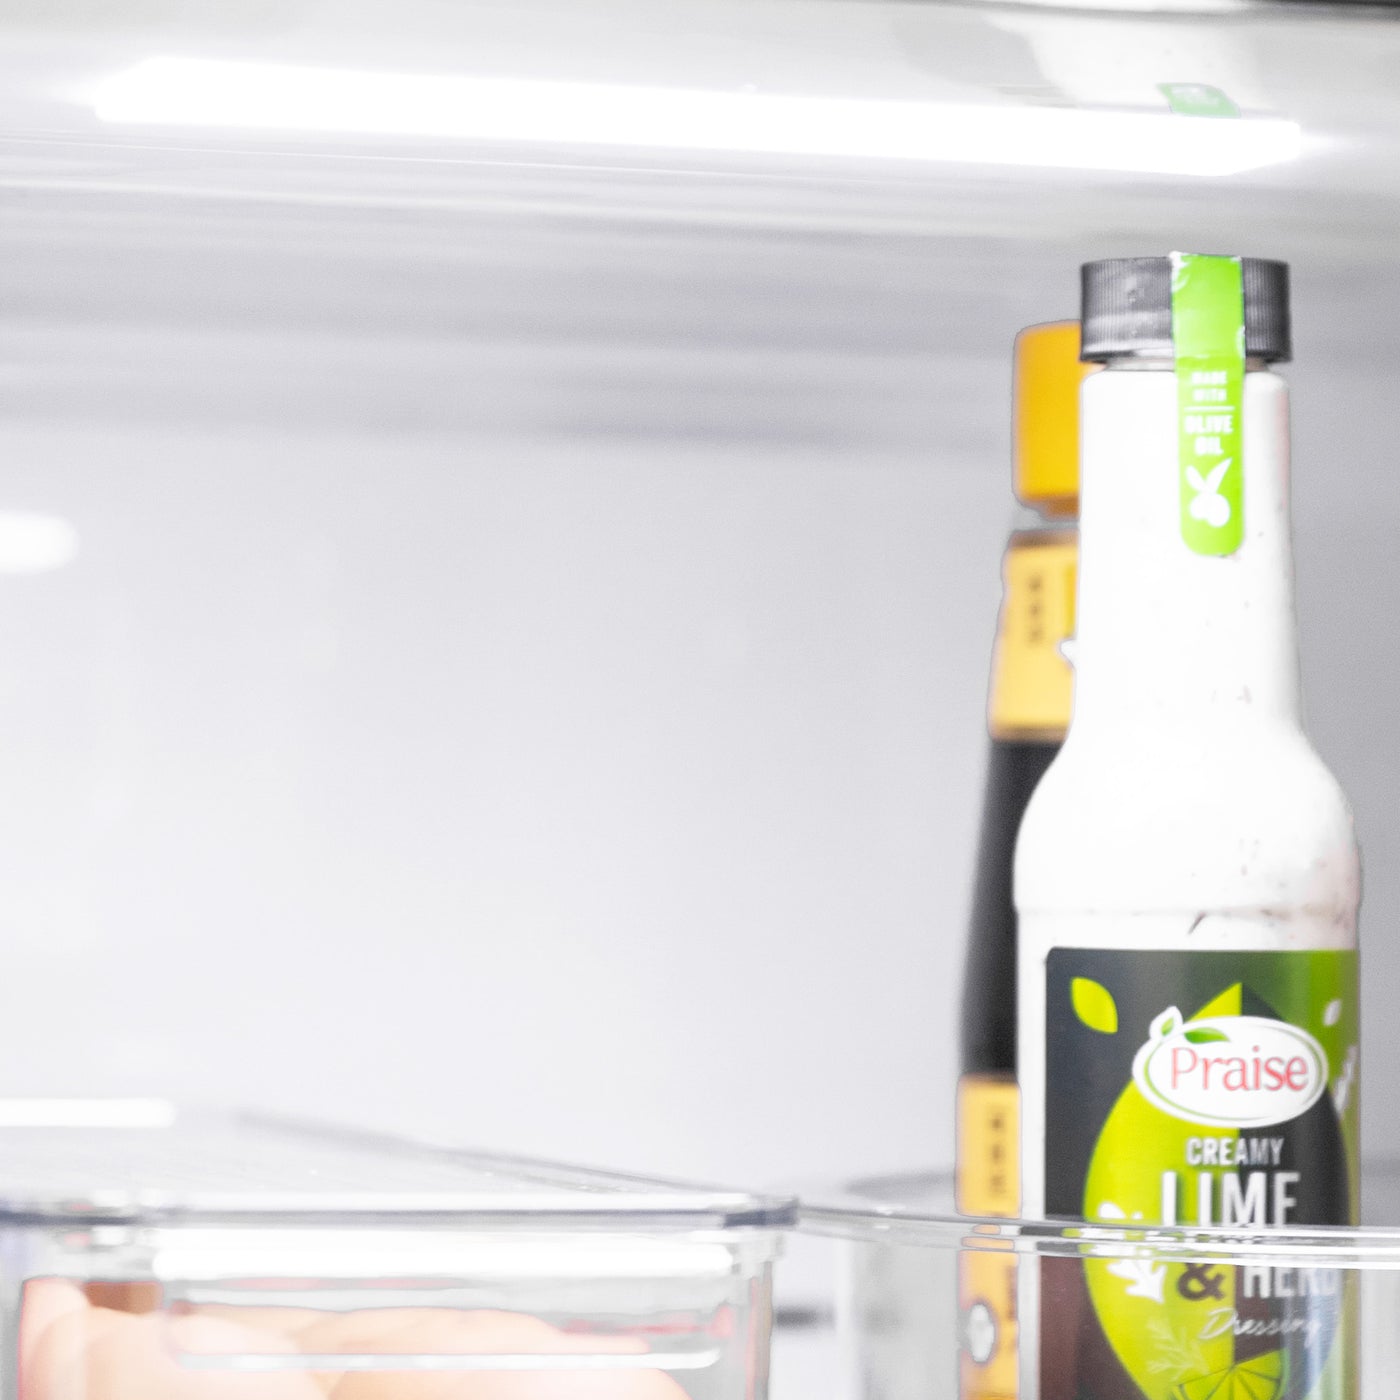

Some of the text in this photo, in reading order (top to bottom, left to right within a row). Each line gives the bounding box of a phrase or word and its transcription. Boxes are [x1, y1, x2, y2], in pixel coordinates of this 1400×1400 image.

[1185, 415, 1233, 434] OLIVE
[1195, 436, 1224, 455] OIL
[1170, 1045, 1309, 1092] Praise
[1186, 1137, 1285, 1167] CREAMY
[1161, 1170, 1300, 1229] LIME
